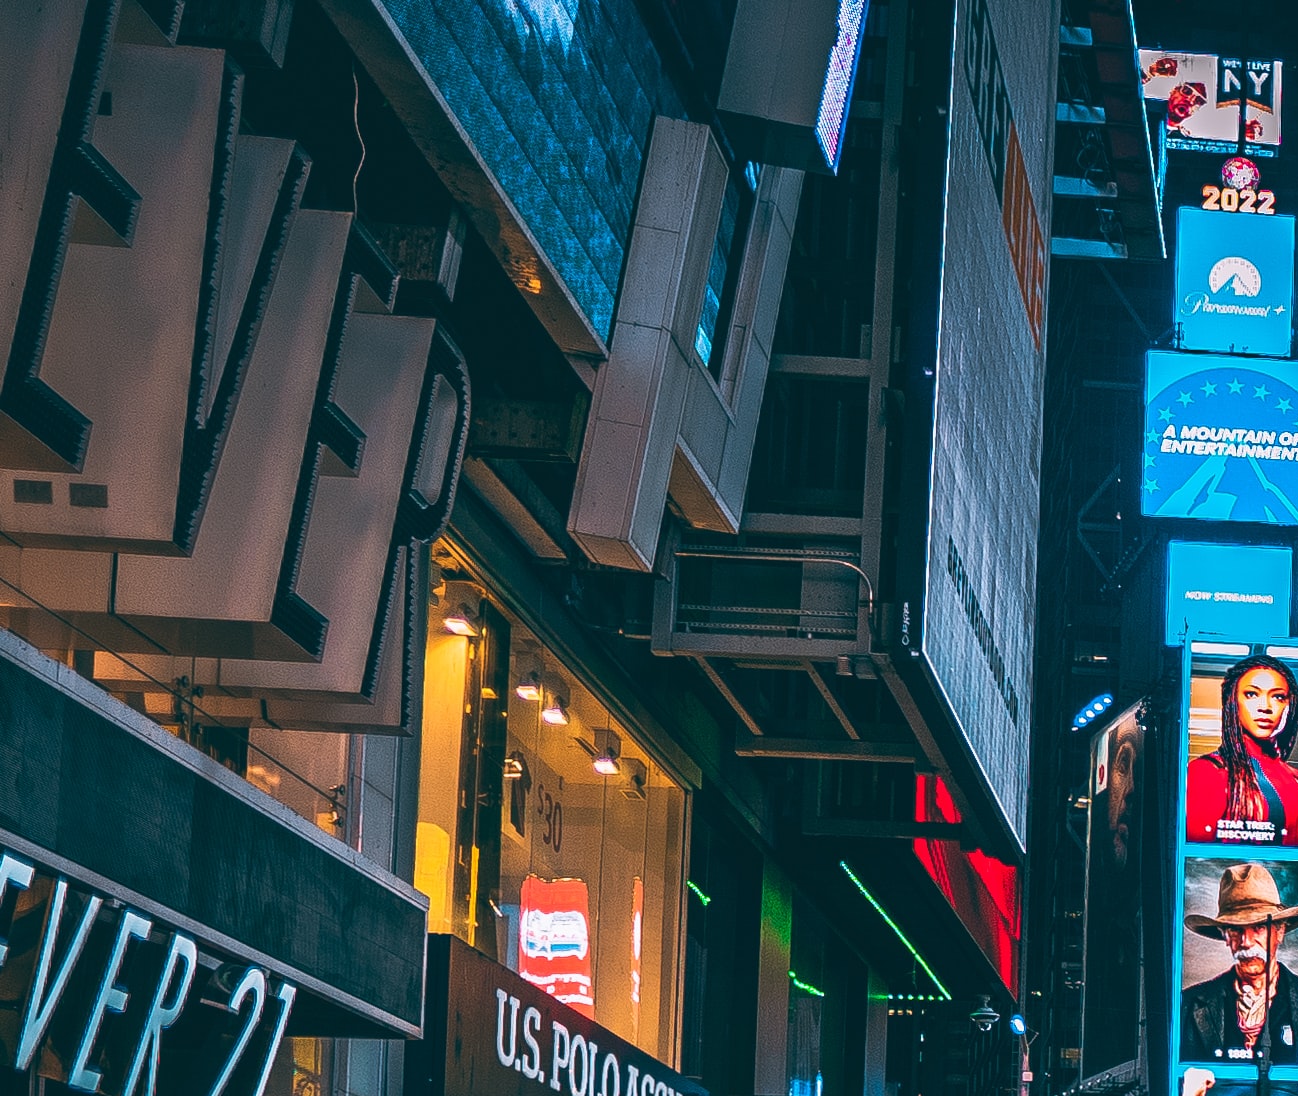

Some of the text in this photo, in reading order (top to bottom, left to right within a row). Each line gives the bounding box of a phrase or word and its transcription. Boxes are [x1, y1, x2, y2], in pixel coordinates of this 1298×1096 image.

[1202, 184, 1275, 215] 2022
[1163, 425, 1176, 439] A
[1180, 426, 1276, 446] MOUNTAIN
[1216, 831, 1275, 841] DISCOVERY
[1217, 820, 1244, 831] STAR
[496, 988, 545, 1084] U.S.
